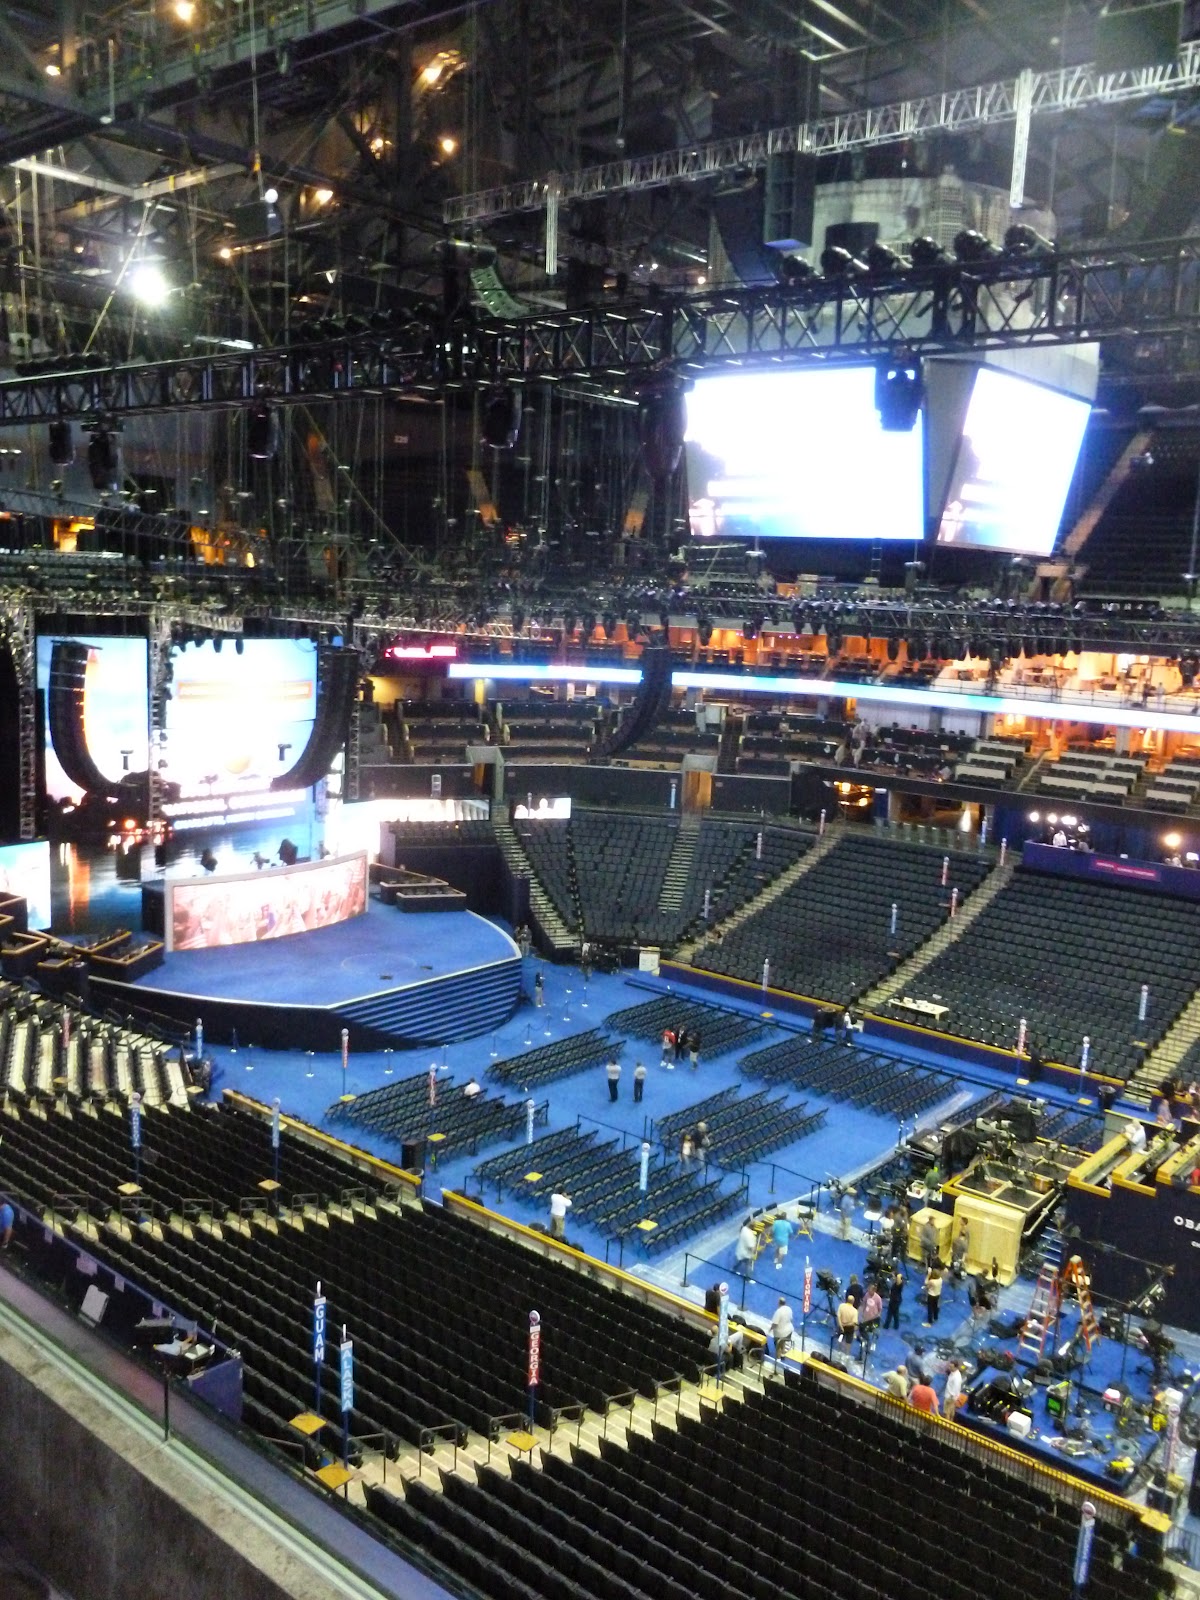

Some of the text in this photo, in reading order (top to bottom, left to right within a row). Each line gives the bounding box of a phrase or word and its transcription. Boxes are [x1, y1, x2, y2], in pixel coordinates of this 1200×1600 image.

[803, 1272, 812, 1313] WYOMING
[314, 1304, 325, 1362] GUAM
[529, 1332, 540, 1386] GEORGIA
[342, 1349, 353, 1411] ALASKA
